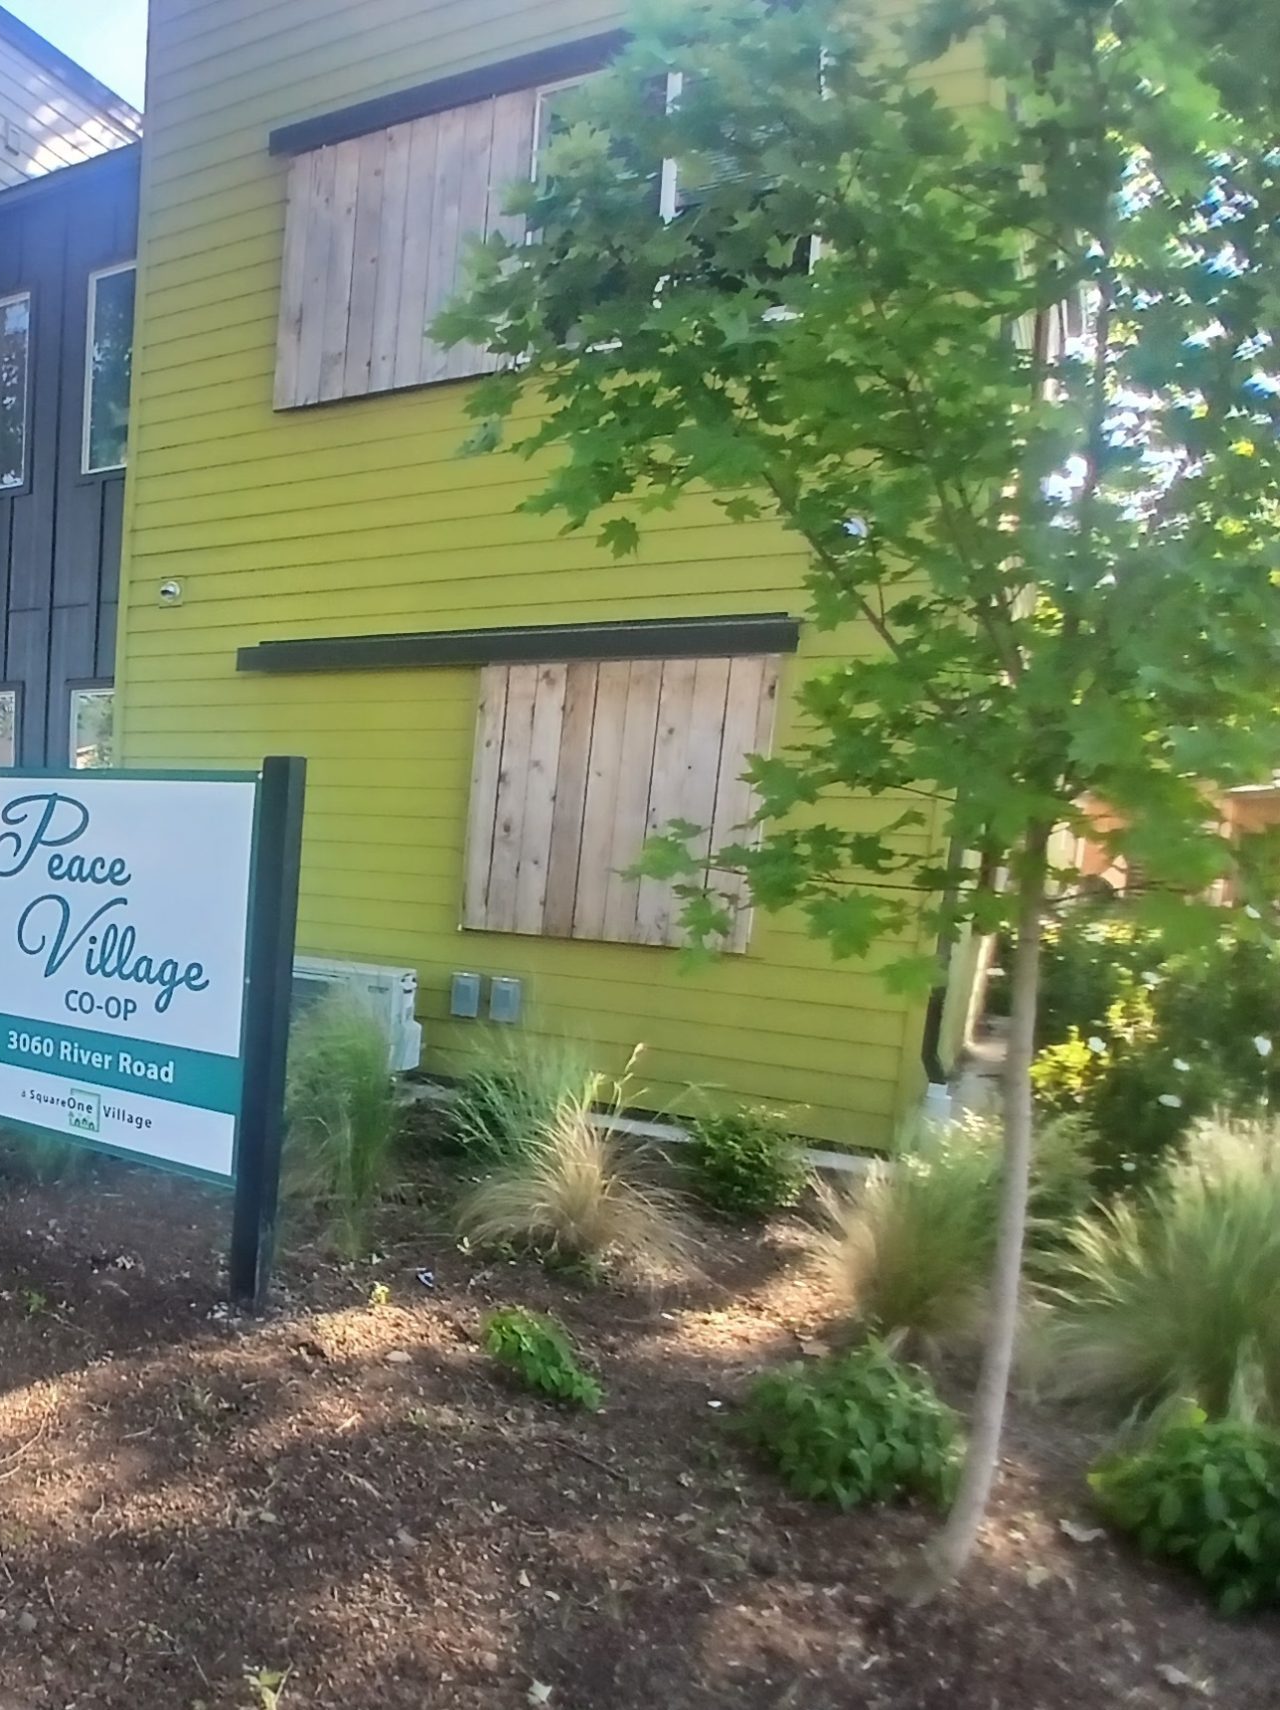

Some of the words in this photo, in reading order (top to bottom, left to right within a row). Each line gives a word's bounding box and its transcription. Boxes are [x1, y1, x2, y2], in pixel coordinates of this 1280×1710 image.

[17, 894, 209, 1013] Village
[64, 989, 138, 1022] CO-OP
[7, 1030, 54, 1058] 3060
[59, 1040, 113, 1070] River
[118, 1051, 175, 1084] Road
[103, 1105, 152, 1129] Village
